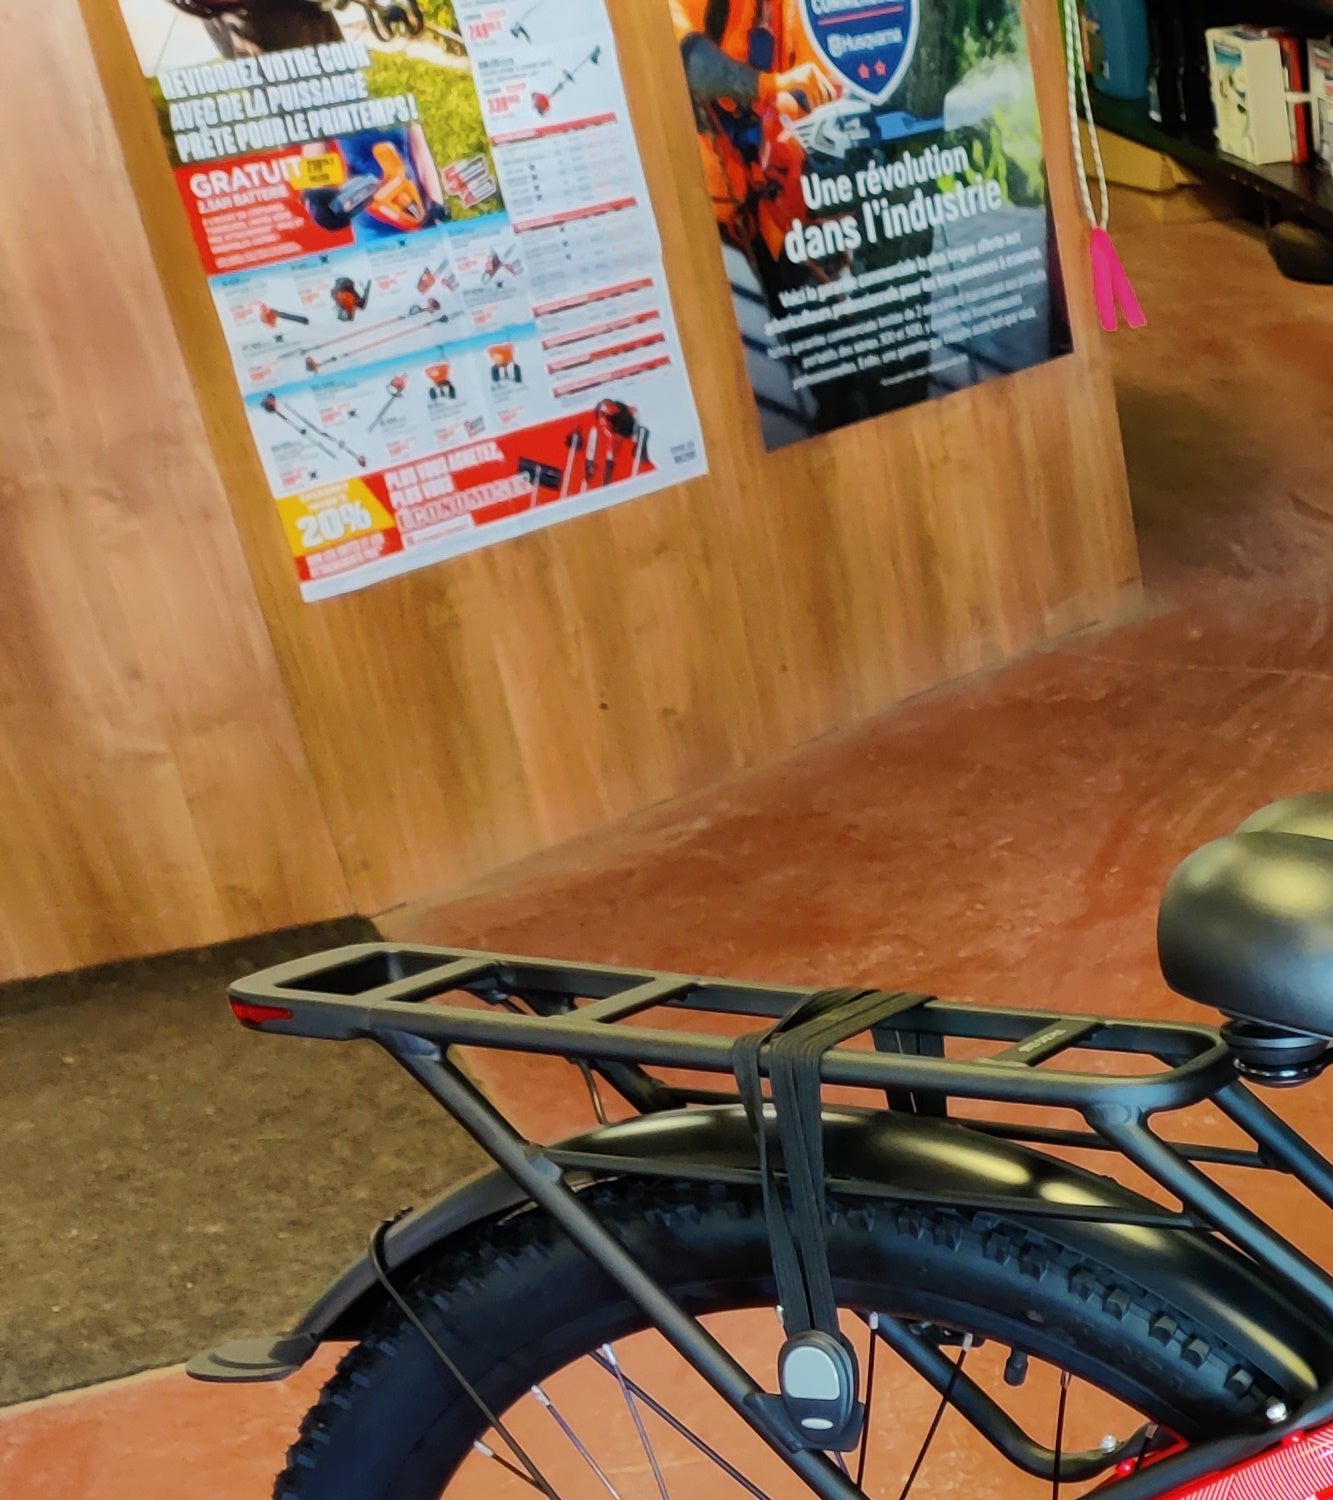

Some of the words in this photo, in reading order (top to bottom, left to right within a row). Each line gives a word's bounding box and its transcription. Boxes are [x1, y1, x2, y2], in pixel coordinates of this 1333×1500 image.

[158, 57, 263, 99] REVIGOREZ
[258, 47, 322, 83] VOTRE
[170, 97, 218, 131] AVEC
[217, 92, 243, 122] DE
[243, 88, 269, 118] LA
[266, 71, 368, 113] PUISSANCE
[235, 116, 288, 150] POUR
[285, 112, 309, 142] LE
[307, 95, 410, 138] PRINTEMPS
[190, 155, 302, 199] GRATUIT
[801, 172, 852, 211] Une
[856, 144, 968, 206] révolution
[785, 214, 862, 264] dans
[862, 178, 1002, 243] l'industrie
[297, 501, 372, 548] 20%
